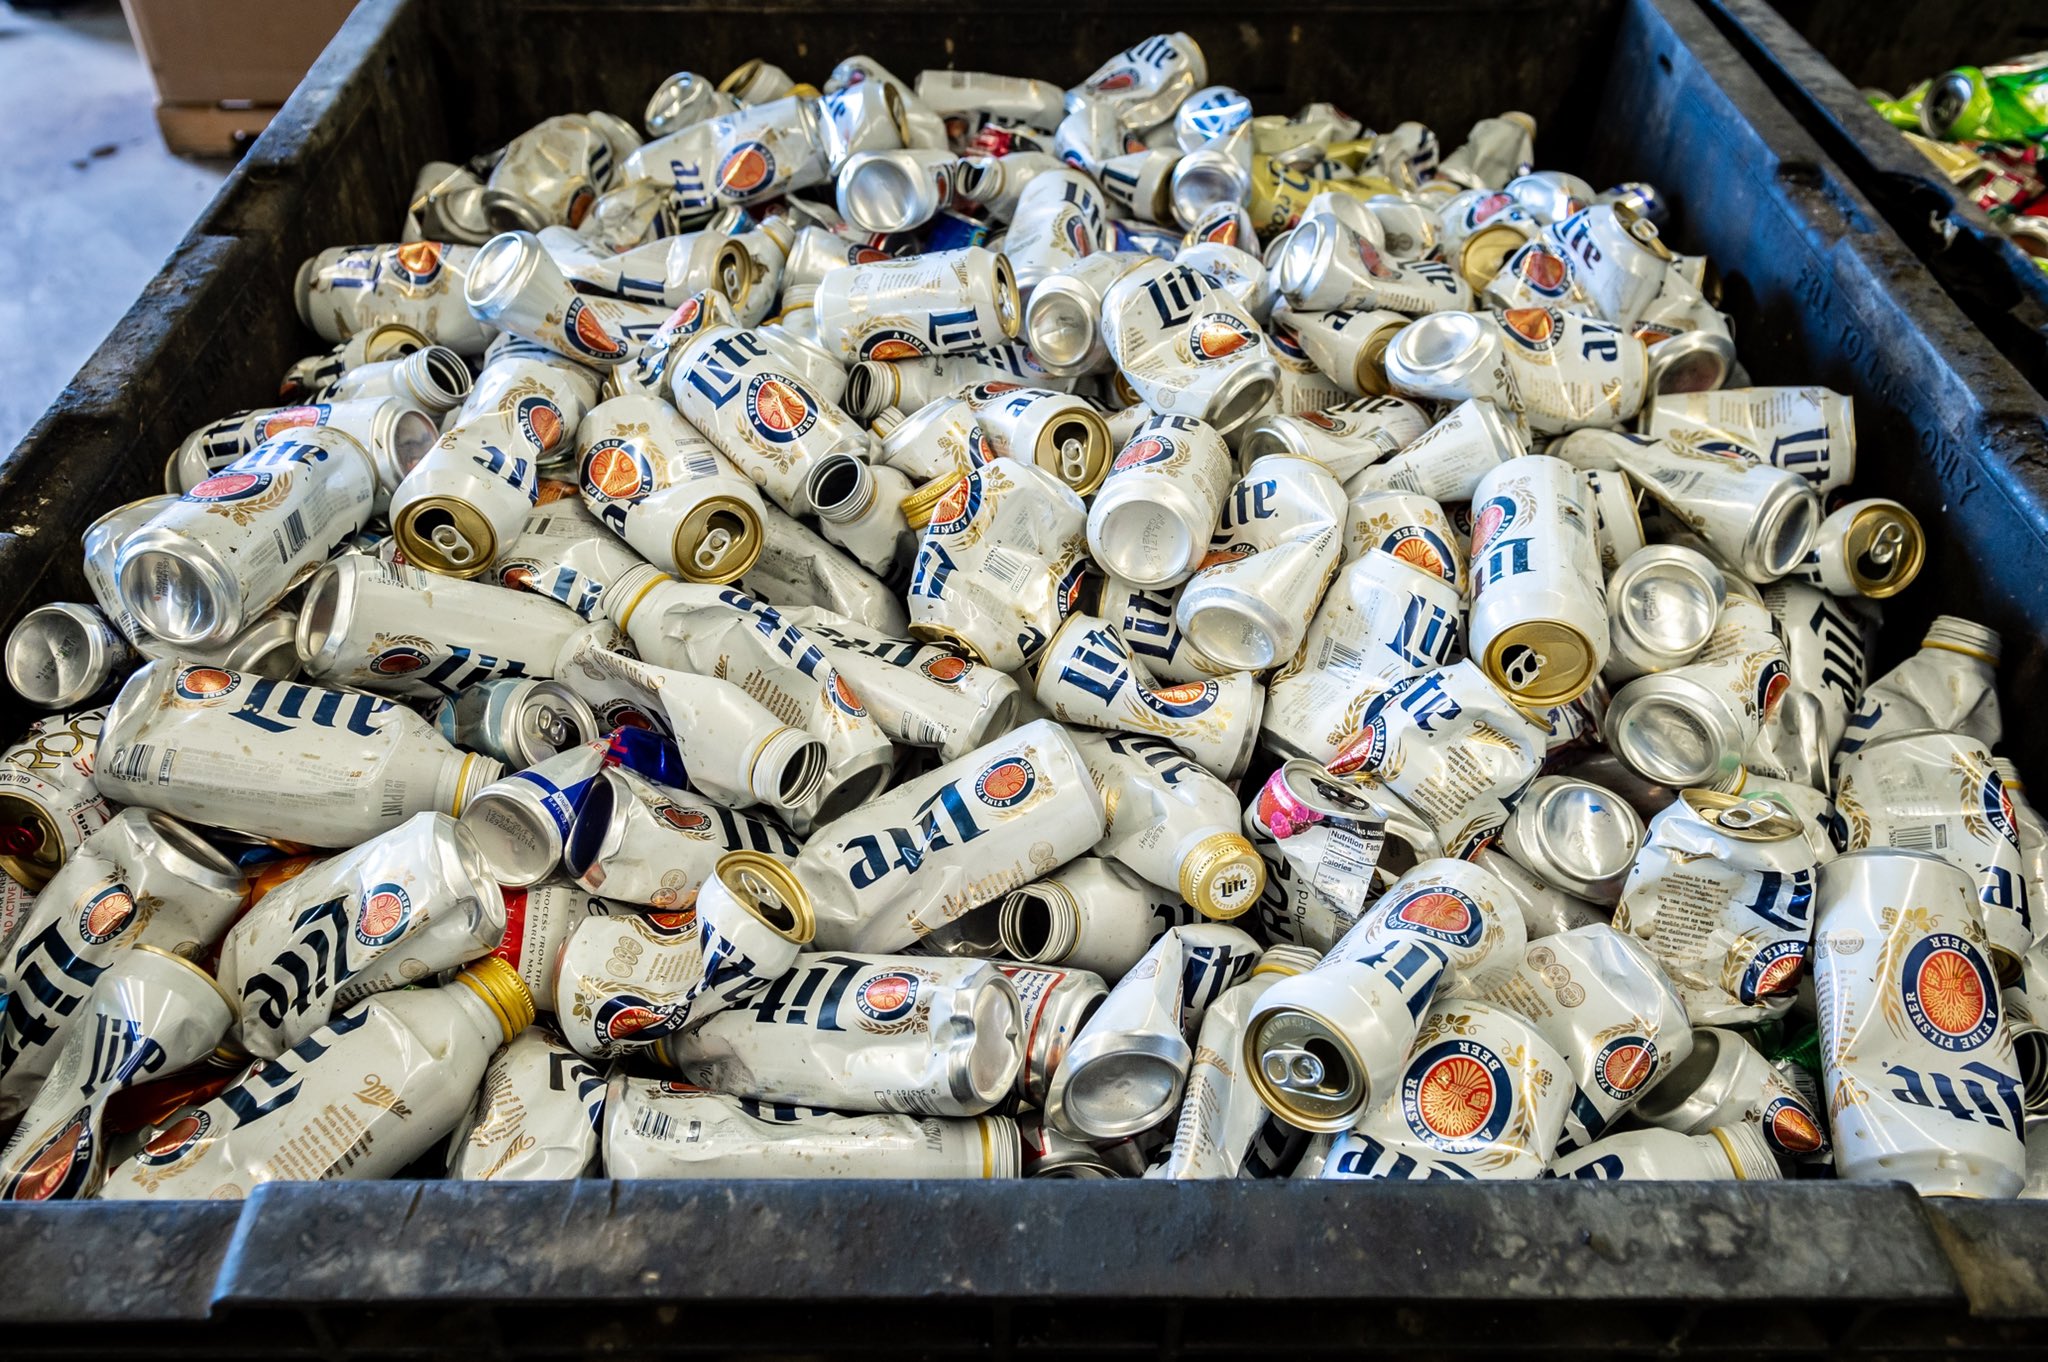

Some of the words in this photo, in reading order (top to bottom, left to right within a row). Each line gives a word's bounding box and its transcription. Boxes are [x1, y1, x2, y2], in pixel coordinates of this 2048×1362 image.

[565, 297, 584, 328] BEER
[929, 305, 986, 352] Lit
[902, 332, 931, 353] FINE
[683, 331, 767, 410] Lite
[752, 372, 799, 392] PILSNER
[589, 438, 620, 456] BEER
[791, 414, 817, 439] BEER
[1771, 426, 1830, 485] Lit
[1921, 427, 1980, 505] ONLY
[1211, 478, 1279, 545] ite
[1393, 525, 1425, 541] BEER
[1472, 537, 1537, 601] Lit
[1124, 588, 1182, 665] Lit
[1386, 591, 1458, 668] Lit
[418, 644, 532, 700] Lit
[1059, 624, 1130, 707] Lit
[1467, 720, 1521, 752] Miller
[1019, 760, 1034, 779] BEER
[77, 813, 91, 838] acts
[843, 779, 990, 890] Lite
[1331, 830, 1364, 849] Nutrition
[1322, 856, 1352, 872] Calories
[1221, 879, 1247, 897] Lite
[1746, 869, 1813, 931] Li
[80, 900, 97, 942] PILSNER
[1754, 957, 1765, 971] A
[1765, 941, 1802, 962] FINE
[1933, 937, 1971, 954] BEER
[750, 957, 873, 1032] Lit
[1183, 945, 1255, 1009] ite
[1357, 940, 1449, 1028] Lit
[1905, 991, 1955, 1049] PILSNER
[1986, 1008, 1996, 1020] A
[81, 1013, 166, 1099] Lite
[1459, 1040, 1501, 1072] BEER
[1960, 1024, 1990, 1048] FINE
[1595, 1048, 1611, 1090] PILSNER
[351, 1072, 413, 1121] Miller
[1764, 1100, 1782, 1123] BEER
[1886, 1061, 2025, 1147] Lite
